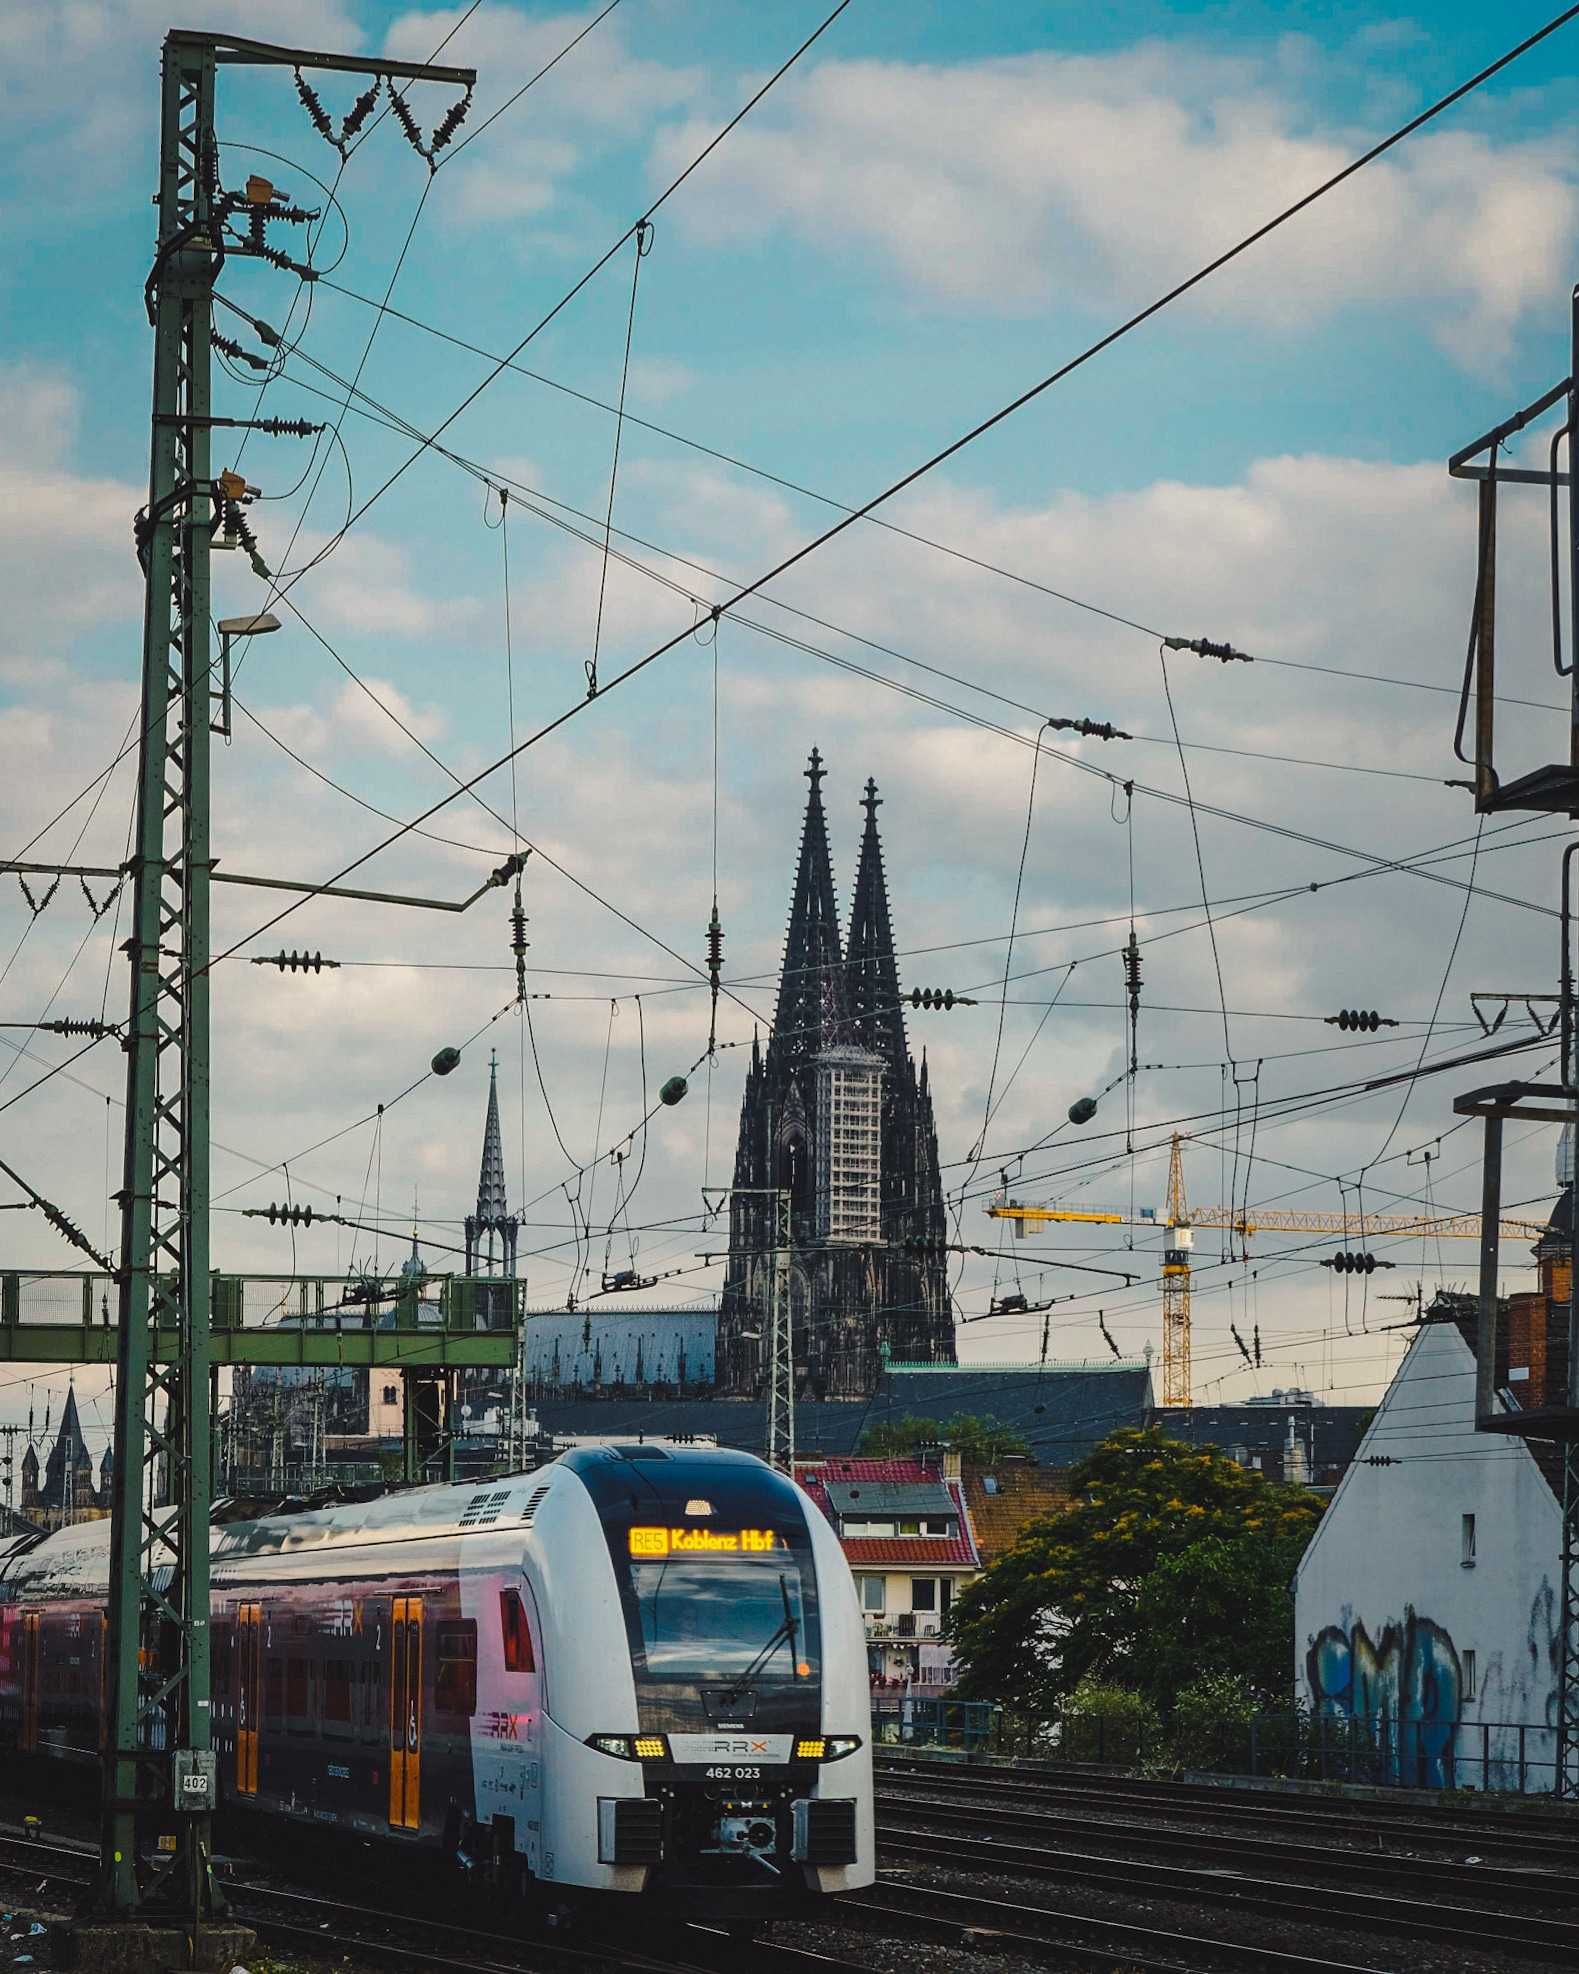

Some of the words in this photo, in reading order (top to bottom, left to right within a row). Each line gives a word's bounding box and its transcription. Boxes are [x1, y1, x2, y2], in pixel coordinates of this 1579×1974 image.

[632, 1530, 666, 1553] RE5
[671, 1529, 738, 1551] Koblenz
[740, 1529, 775, 1551] Hbf
[714, 1741, 768, 1752] RRX
[706, 1767, 732, 1779] 462
[735, 1767, 761, 1779] 023
[185, 1777, 206, 1789] 402
